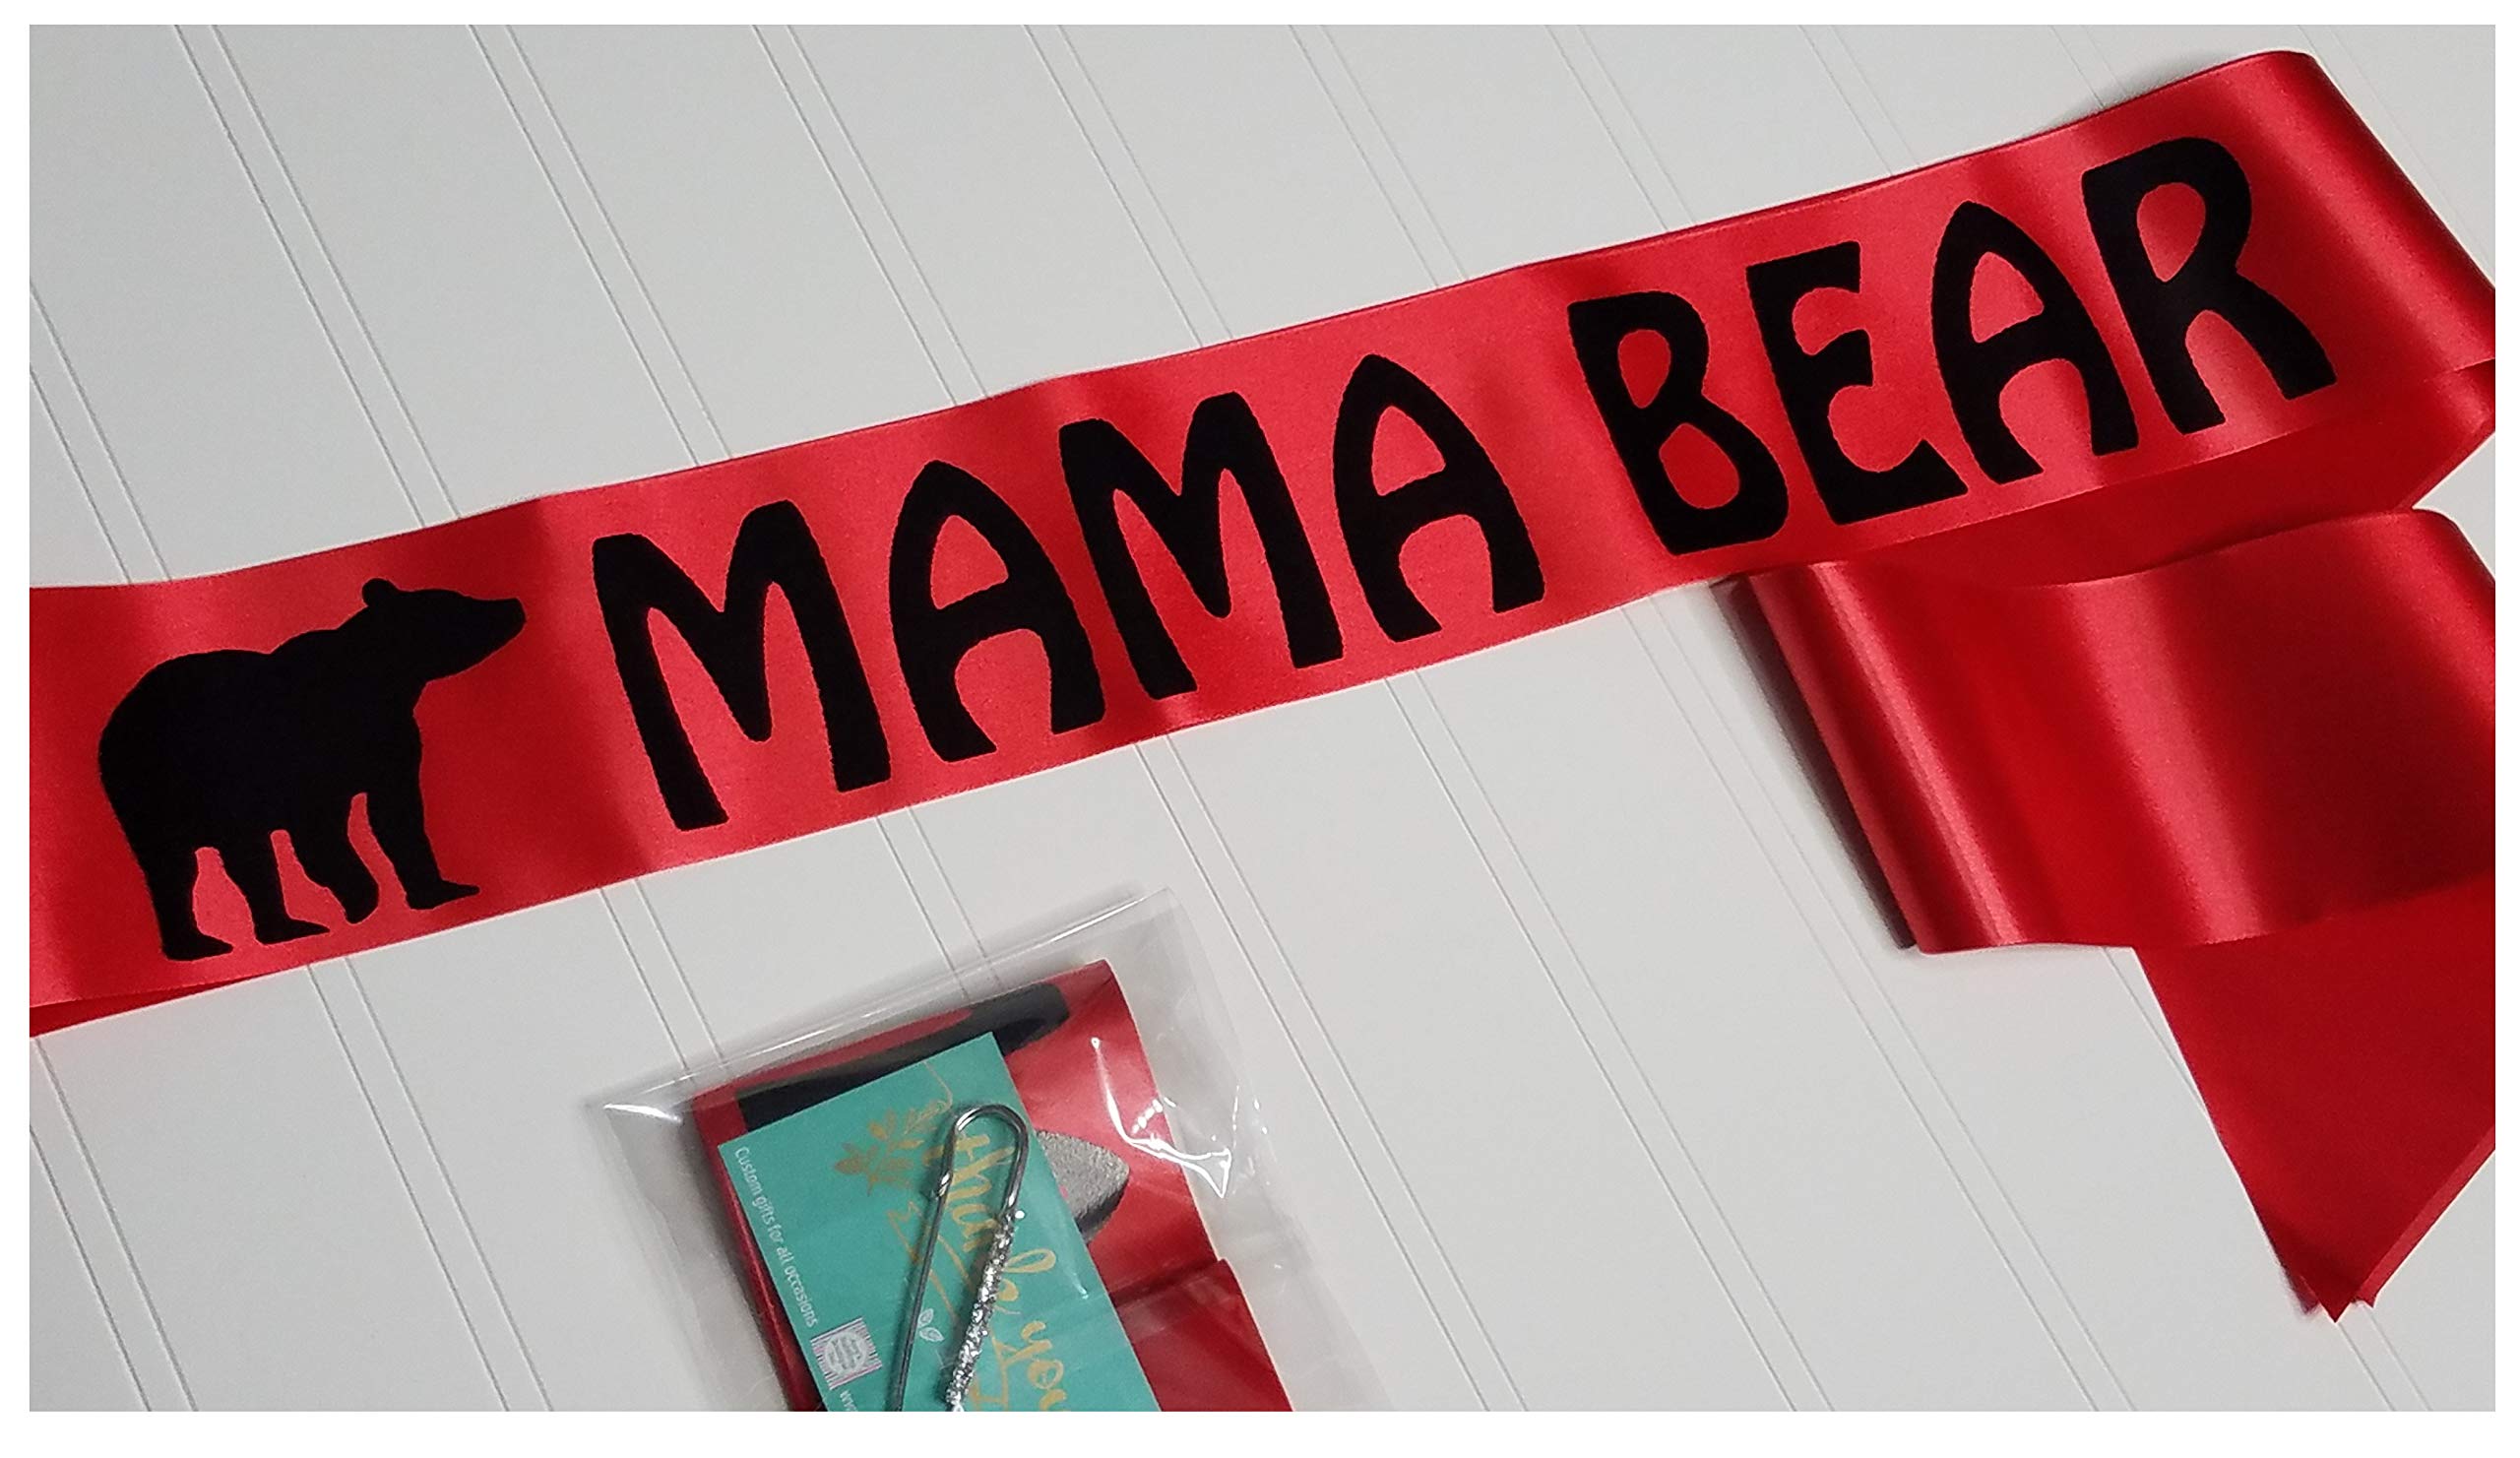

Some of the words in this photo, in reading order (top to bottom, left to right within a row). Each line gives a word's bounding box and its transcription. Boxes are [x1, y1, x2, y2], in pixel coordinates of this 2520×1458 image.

[592, 354, 1544, 832] MAMA
[1568, 136, 2338, 555] BEAR
[734, 1146, 763, 1196] Custom
[752, 1195, 776, 1226] gifts
[767, 1223, 785, 1244] for
[776, 1245, 794, 1267] all
[784, 1266, 818, 1328] occasions
